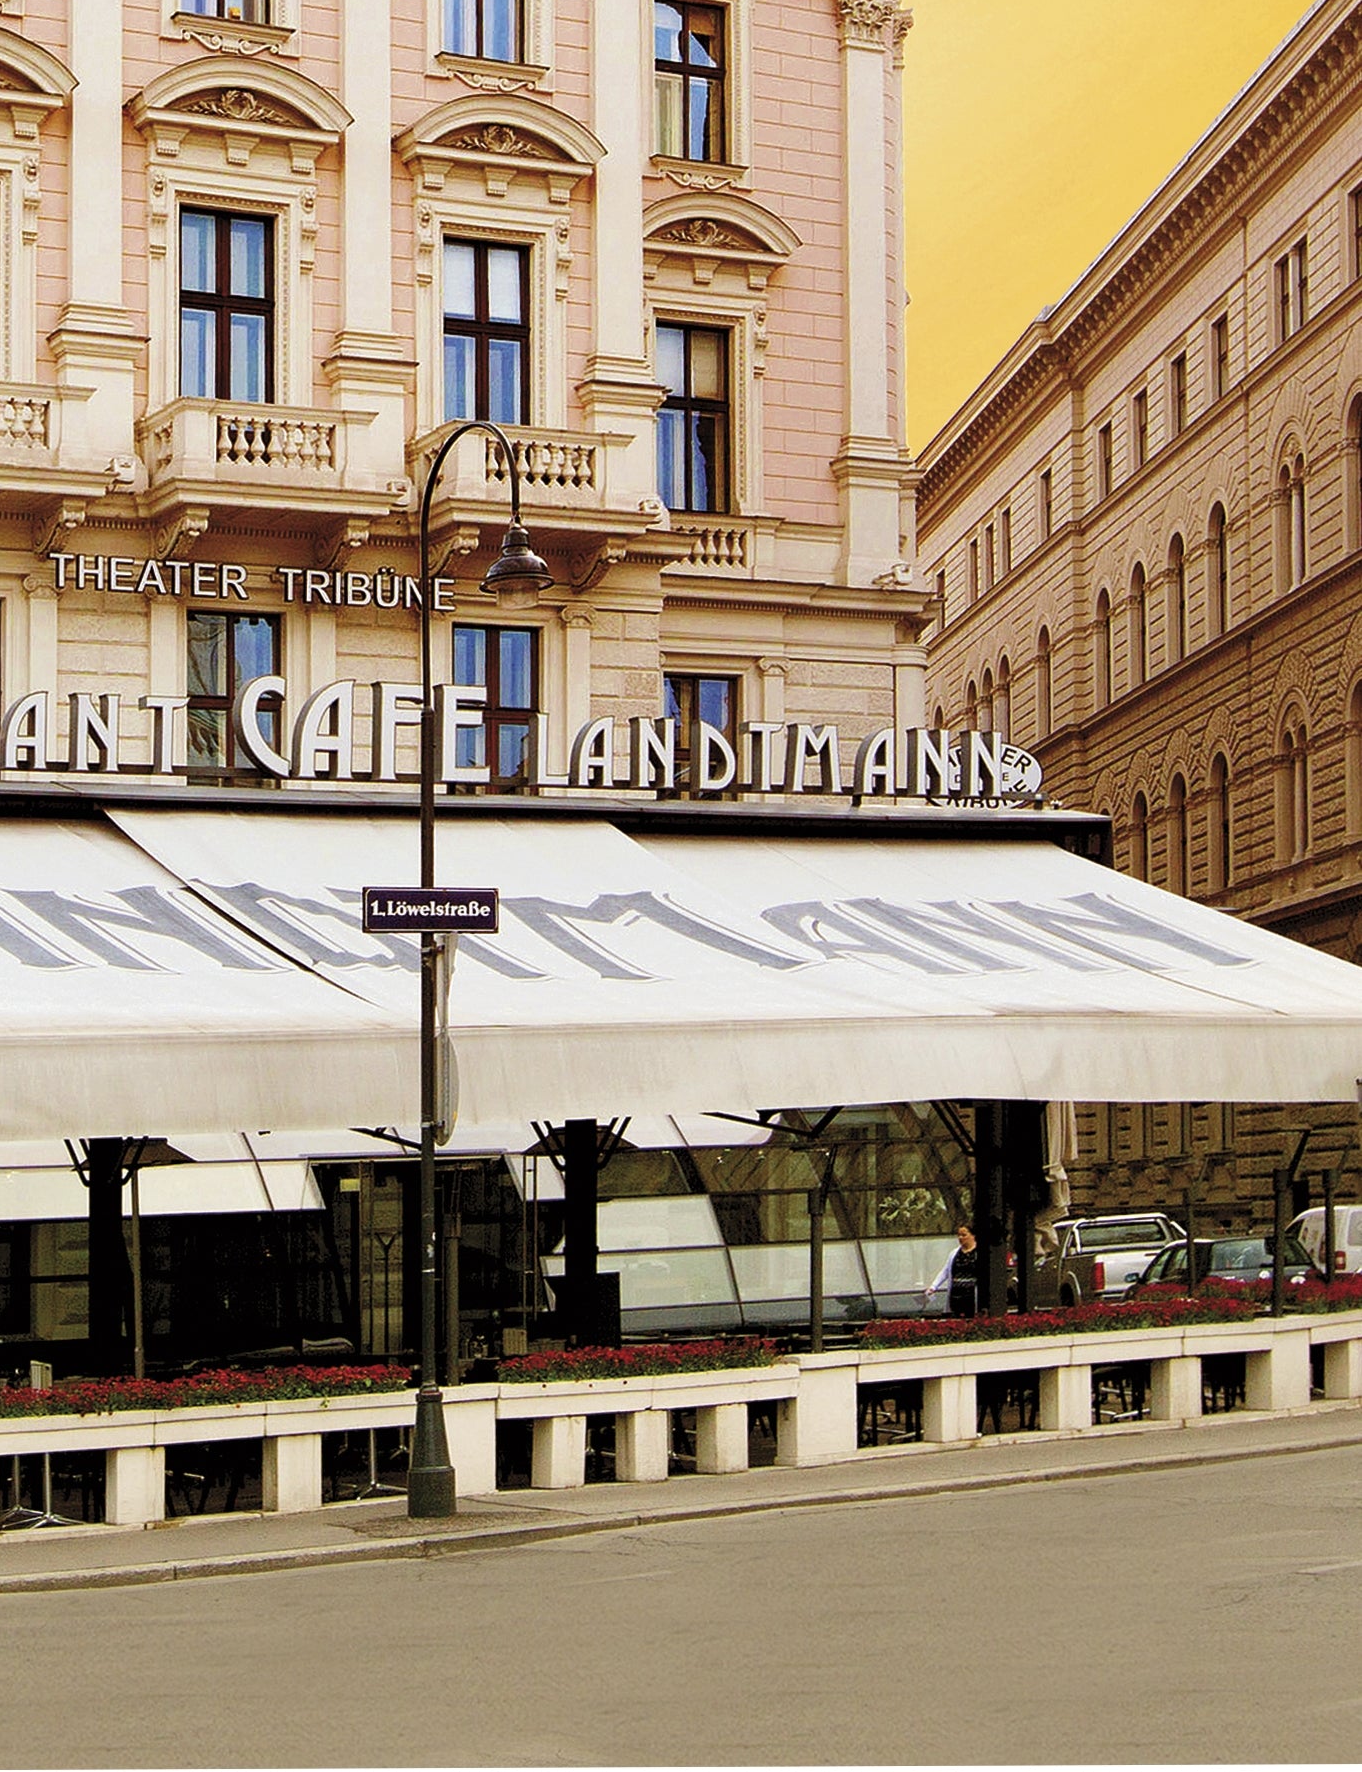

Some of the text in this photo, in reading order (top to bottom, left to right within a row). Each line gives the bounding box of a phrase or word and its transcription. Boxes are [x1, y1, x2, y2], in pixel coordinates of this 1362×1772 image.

[49, 552, 456, 611] THEATER TRIBÜNE
[233, 674, 491, 784] CAFE
[530, 712, 1003, 797] LANDTMANN
[387, 900, 491, 917] Löwelstraße
